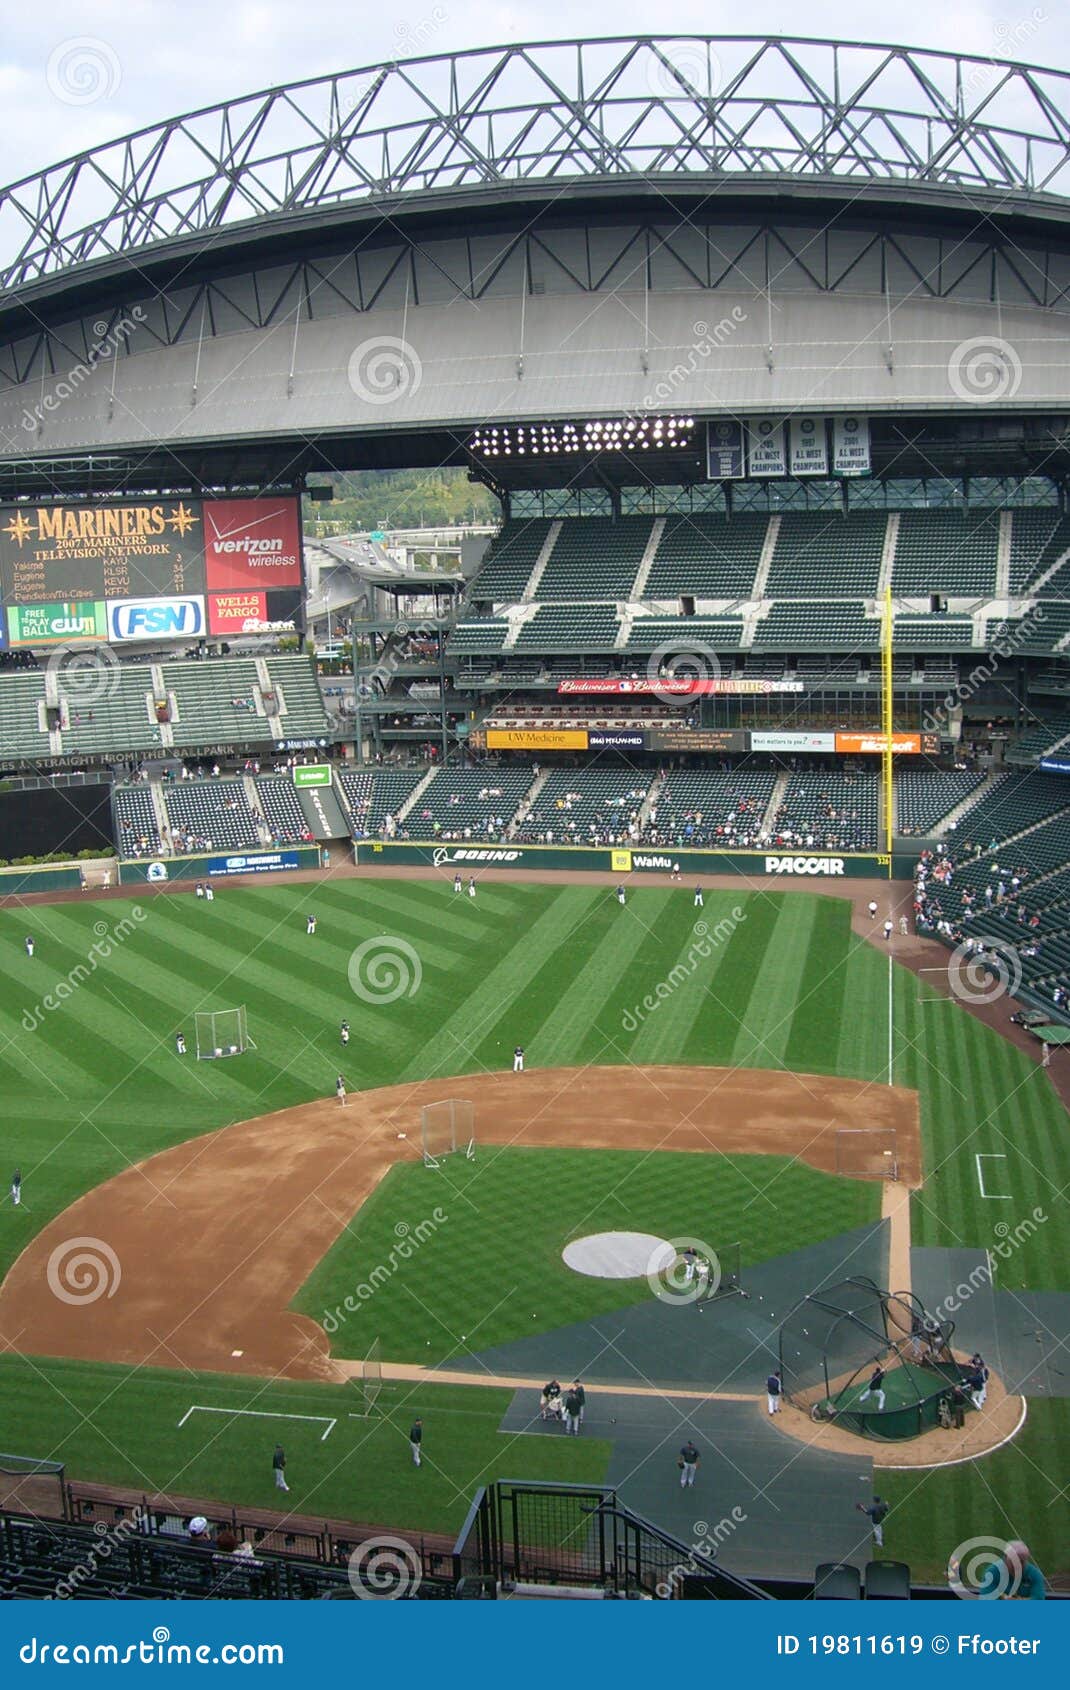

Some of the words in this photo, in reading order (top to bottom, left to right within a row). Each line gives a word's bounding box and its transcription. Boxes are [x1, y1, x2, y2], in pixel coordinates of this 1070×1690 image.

[751, 463, 784, 473] CHAMPIONS
[792, 461, 825, 471] CHAMPIONS
[37, 506, 166, 541] MARINERS
[55, 538, 82, 550] 2007
[83, 535, 147, 549] MARINERS
[213, 536, 283, 555] verizon
[33, 549, 108, 561] TELEVISION
[108, 543, 170, 557] NETWORK
[248, 554, 296, 568] wireless
[14, 572, 45, 583] Eugene
[14, 582, 46, 593] Eugene
[104, 577, 130, 587] KEVU
[215, 596, 259, 607] WELLS
[25, 609, 45, 618] FREE
[127, 604, 188, 634] FSN
[217, 607, 260, 618] FARGO
[28, 618, 50, 627] PLAY
[23, 626, 51, 637] BALL
[560, 679, 617, 693] Budweiser
[632, 679, 692, 693] Budweiser
[507, 733, 525, 743] UW
[526, 733, 567, 743] Medicine
[36, 755, 96, 768] STRAIGHT
[173, 744, 234, 758] BALLPARK
[453, 849, 519, 861] BOEING
[632, 855, 672, 868] WaMu
[765, 856, 844, 875] PACCAR
